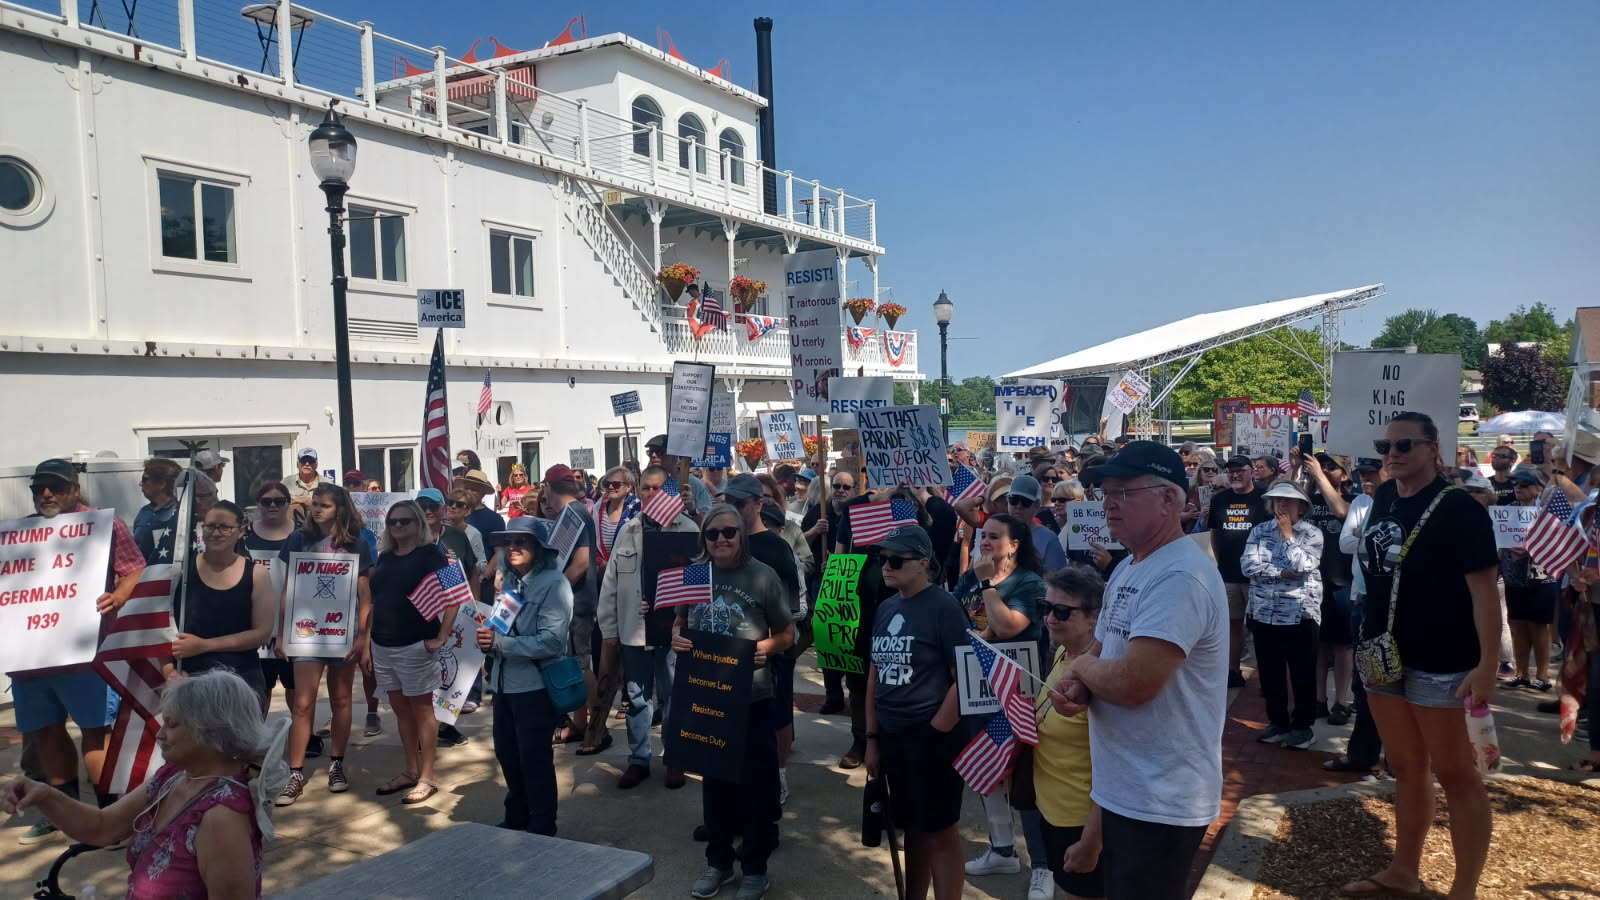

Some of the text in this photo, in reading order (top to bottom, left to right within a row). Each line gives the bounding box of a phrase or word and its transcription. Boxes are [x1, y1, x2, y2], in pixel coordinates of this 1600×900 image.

[787, 267, 833, 285] RESIST!
[421, 313, 462, 322] America
[789, 315, 819, 328] Rapist
[791, 335, 825, 348] Utterly
[793, 354, 832, 367] Moronic
[1383, 365, 1400, 380] NO
[995, 385, 1052, 397] IMPEACH
[1255, 407, 1265, 415] WE
[1267, 407, 1285, 415] HAVE
[770, 414, 786, 423] NO
[858, 409, 920, 429] ALL THAT
[1253, 414, 1282, 430] NO
[769, 423, 793, 432] FAUX
[774, 442, 796, 451] KING
[862, 430, 909, 450] PARADE
[1001, 436, 1046, 447] LEECH
[777, 451, 796, 459] WAY
[866, 451, 890, 468] AND
[906, 449, 937, 464] FOR
[869, 465, 943, 487] VETERANS
[1073, 509, 1084, 518] BB
[1494, 510, 1509, 519] NO
[1223, 522, 1252, 530] ASLEEP
[0, 521, 95, 546] TRUMP CULT
[0, 553, 74, 577] AME AS
[297, 562, 350, 576] NO KINGS
[826, 558, 859, 579] END
[0, 583, 78, 607] GERMANS
[325, 611, 344, 624] NO
[815, 603, 859, 623] DO YOU
[26, 612, 61, 631] 1939
[871, 635, 914, 652] WORST
[692, 649, 712, 662] When
[688, 675, 733, 692] becomes Law
[691, 703, 725, 718] Resistance
[680, 728, 726, 749] becomes Duty
